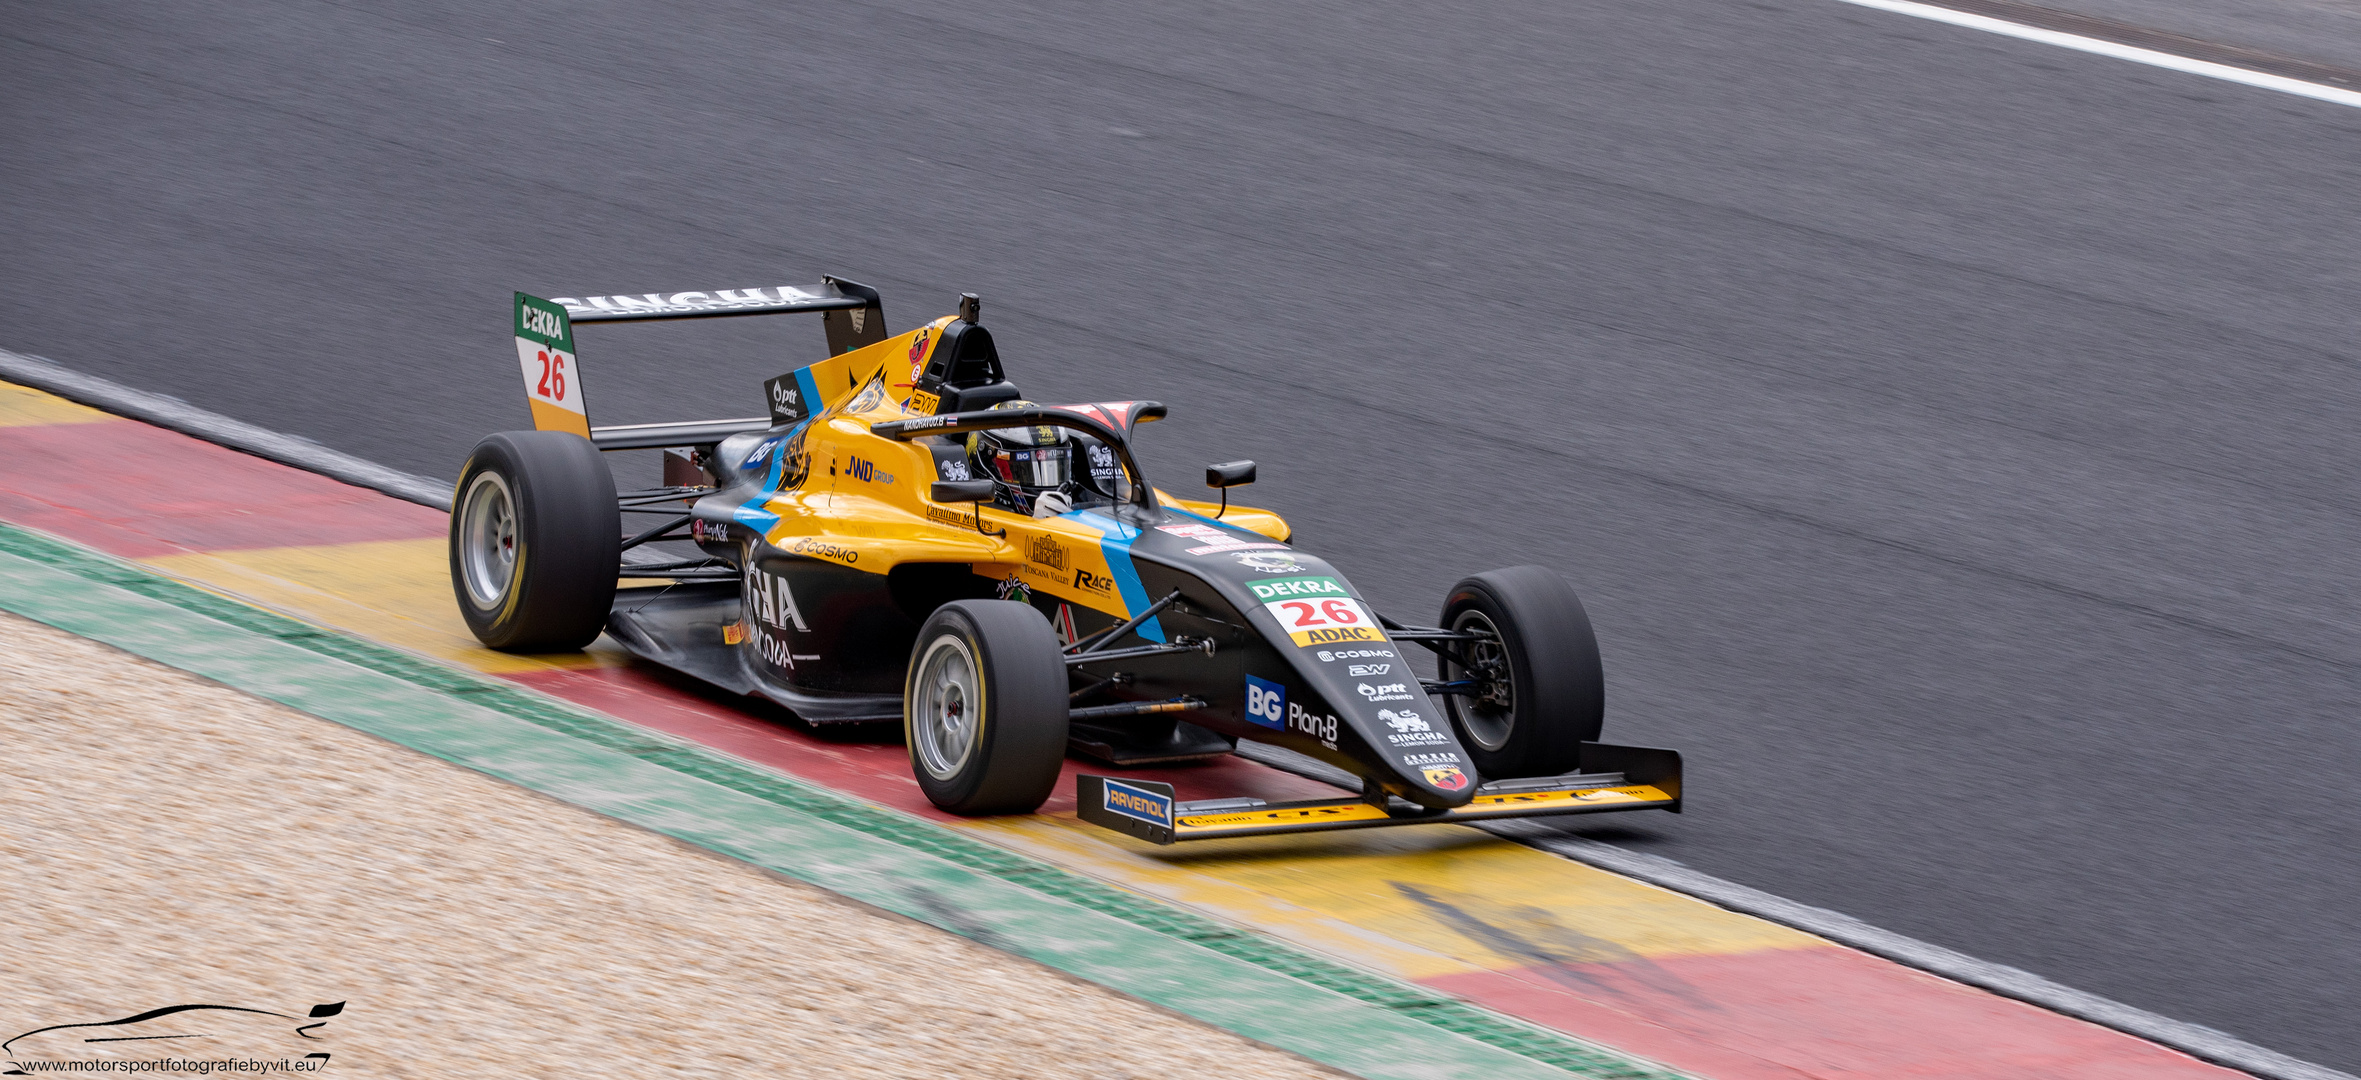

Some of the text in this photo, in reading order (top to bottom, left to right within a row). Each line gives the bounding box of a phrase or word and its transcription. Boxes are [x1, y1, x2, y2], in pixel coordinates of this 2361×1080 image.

[549, 286, 819, 312] SINGHA
[522, 304, 563, 341] DEKRA
[537, 350, 565, 402] 26
[782, 388, 798, 405] ptt
[775, 402, 798, 418] Lubricants
[749, 441, 777, 463] BG
[845, 455, 895, 486] JWD GROUP
[962, 512, 994, 531] Moors
[806, 541, 859, 564] COSMO
[995, 573, 1032, 599] Juice
[1022, 564, 1070, 586] TOSCANA VALLEY
[1073, 568, 1113, 592] RACE
[1252, 580, 1345, 599] DEKRA
[1281, 600, 1359, 627] 26
[1307, 627, 1372, 644] ADAC
[1334, 649, 1395, 659] COSMO
[1368, 693, 1415, 702] Lubricants
[1377, 683, 1407, 695] ptt
[1248, 683, 1282, 722] BG
[1387, 731, 1448, 744] SINGHA
[1110, 789, 1165, 819] RAVENOL
